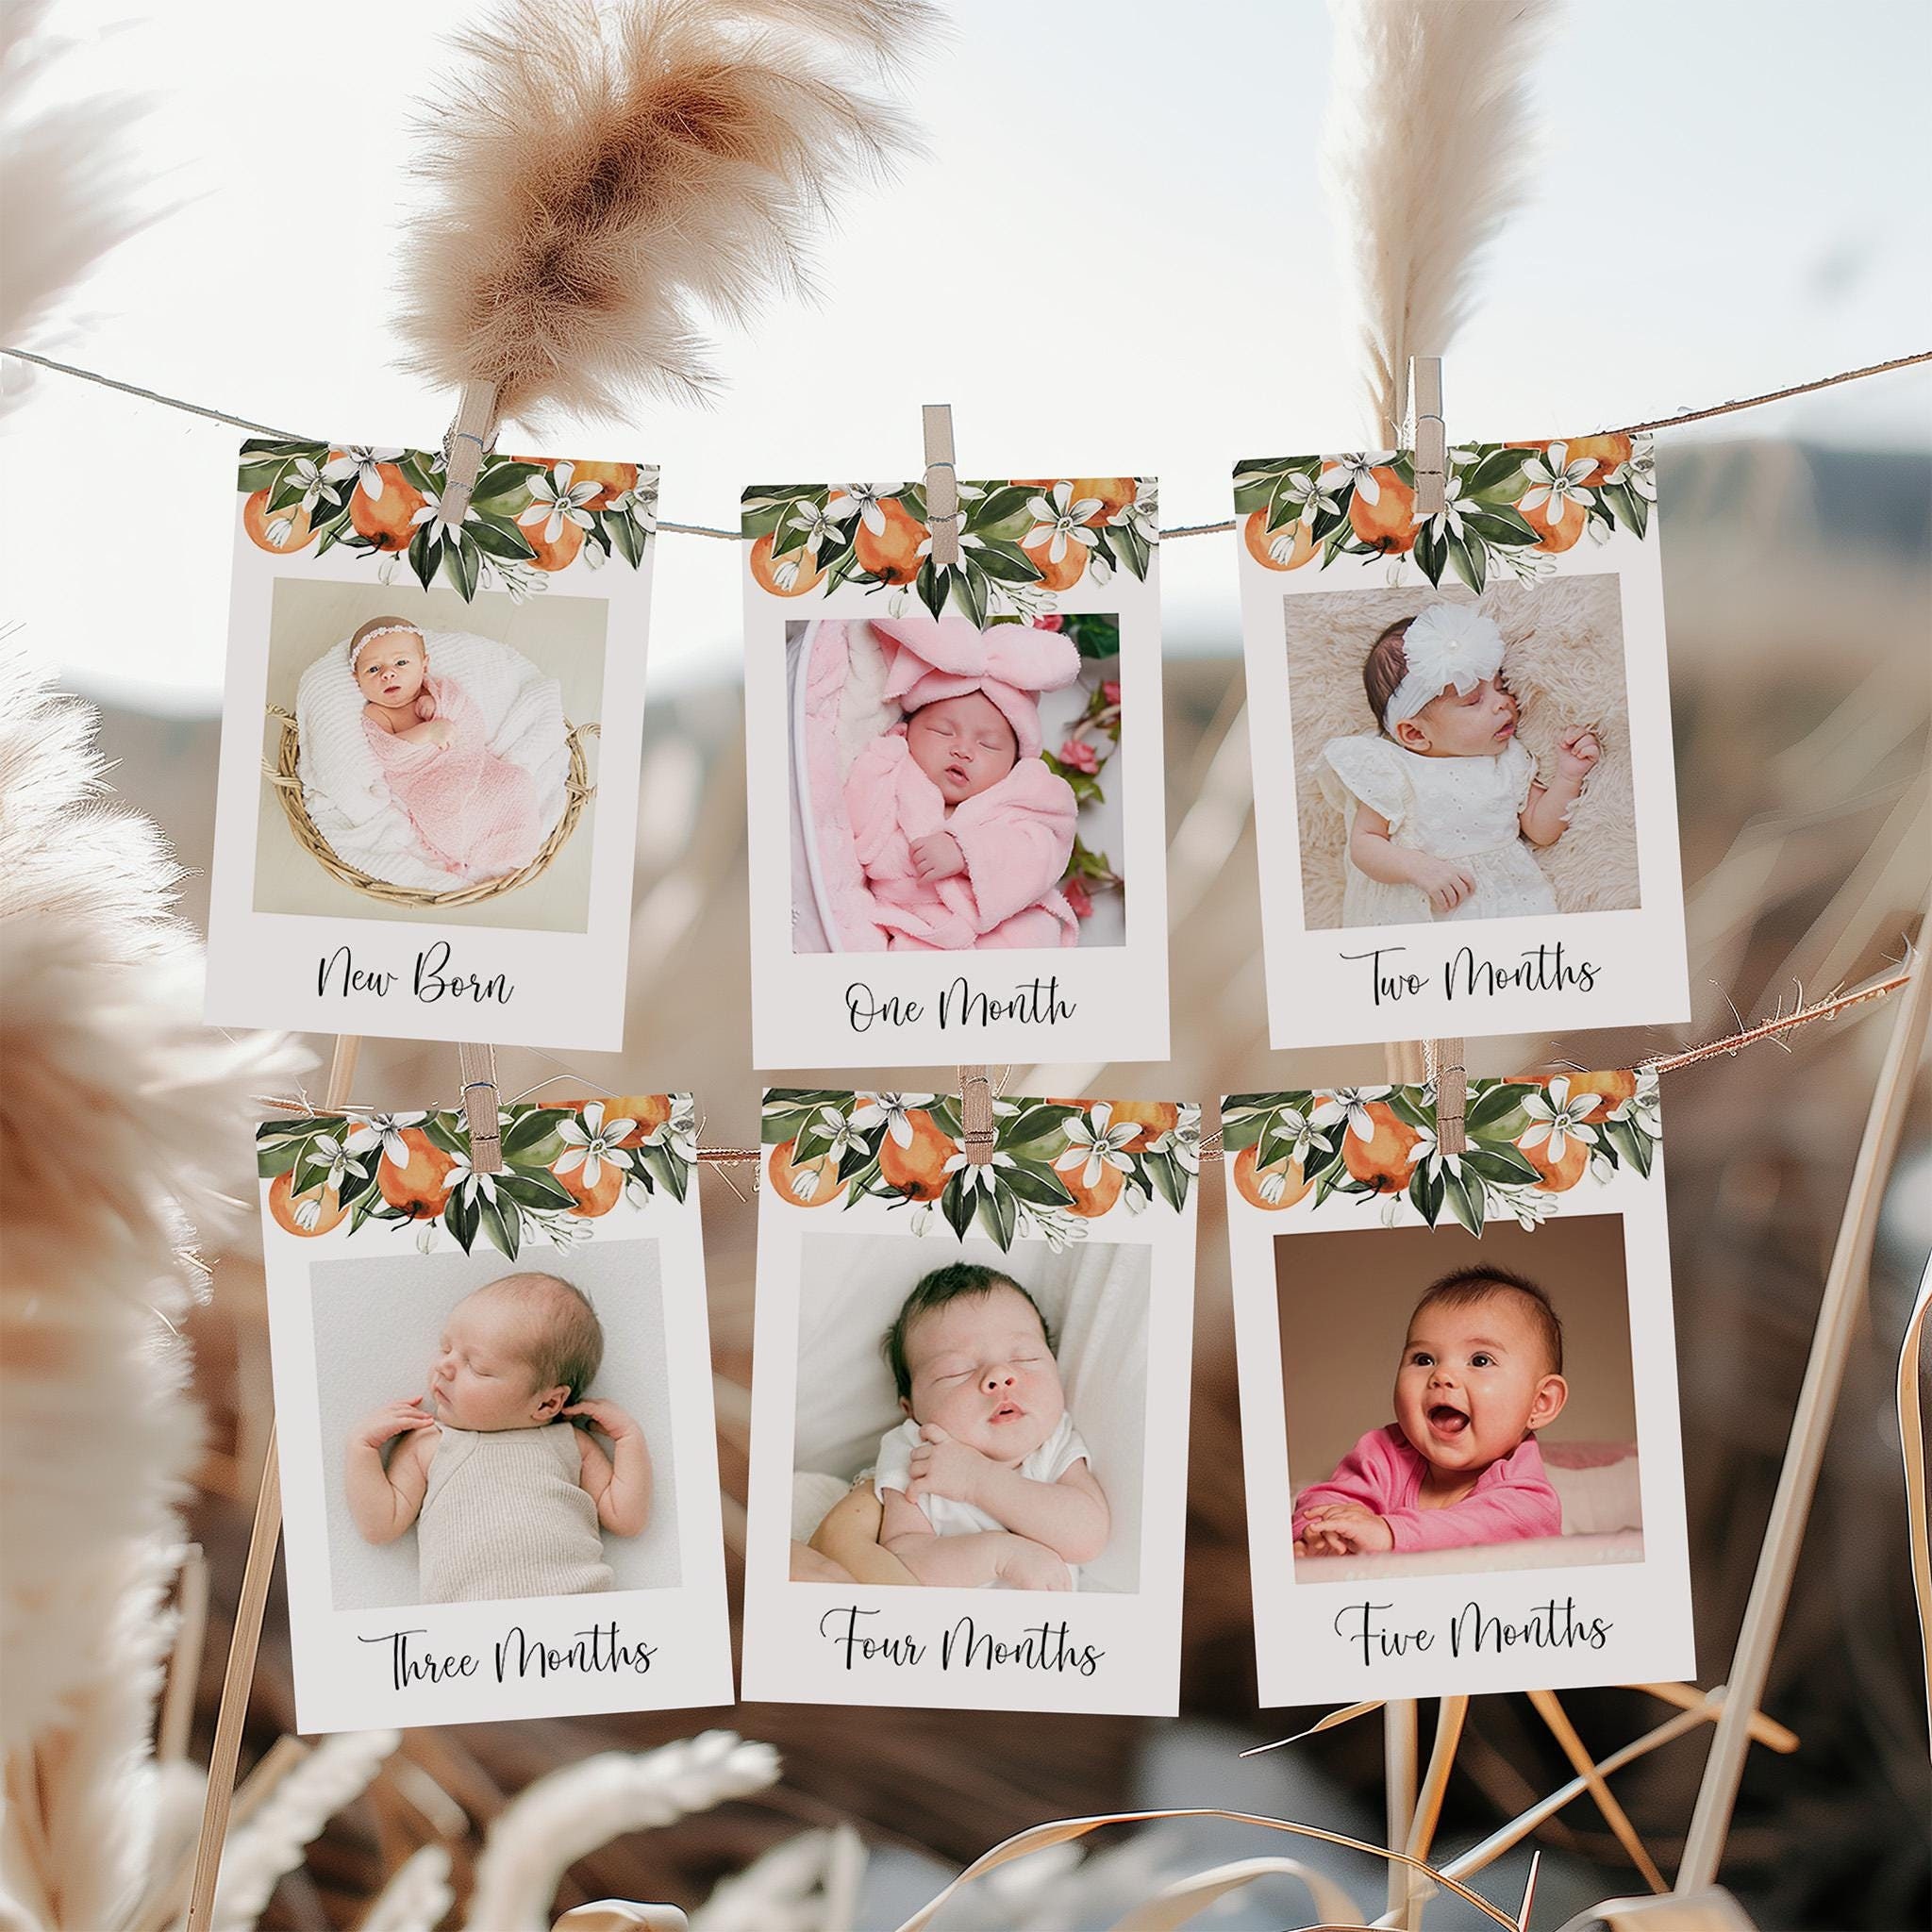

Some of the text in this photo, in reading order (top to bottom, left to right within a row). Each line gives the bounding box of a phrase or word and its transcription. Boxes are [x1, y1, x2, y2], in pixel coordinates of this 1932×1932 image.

[318, 941, 515, 1005] New Born
[844, 975, 1077, 1033] One Month
[1339, 941, 1602, 1007] Two Months
[357, 1621, 658, 1691] Three Months
[819, 1605, 1106, 1677] Four Months
[1334, 1596, 1614, 1667] Five Months
